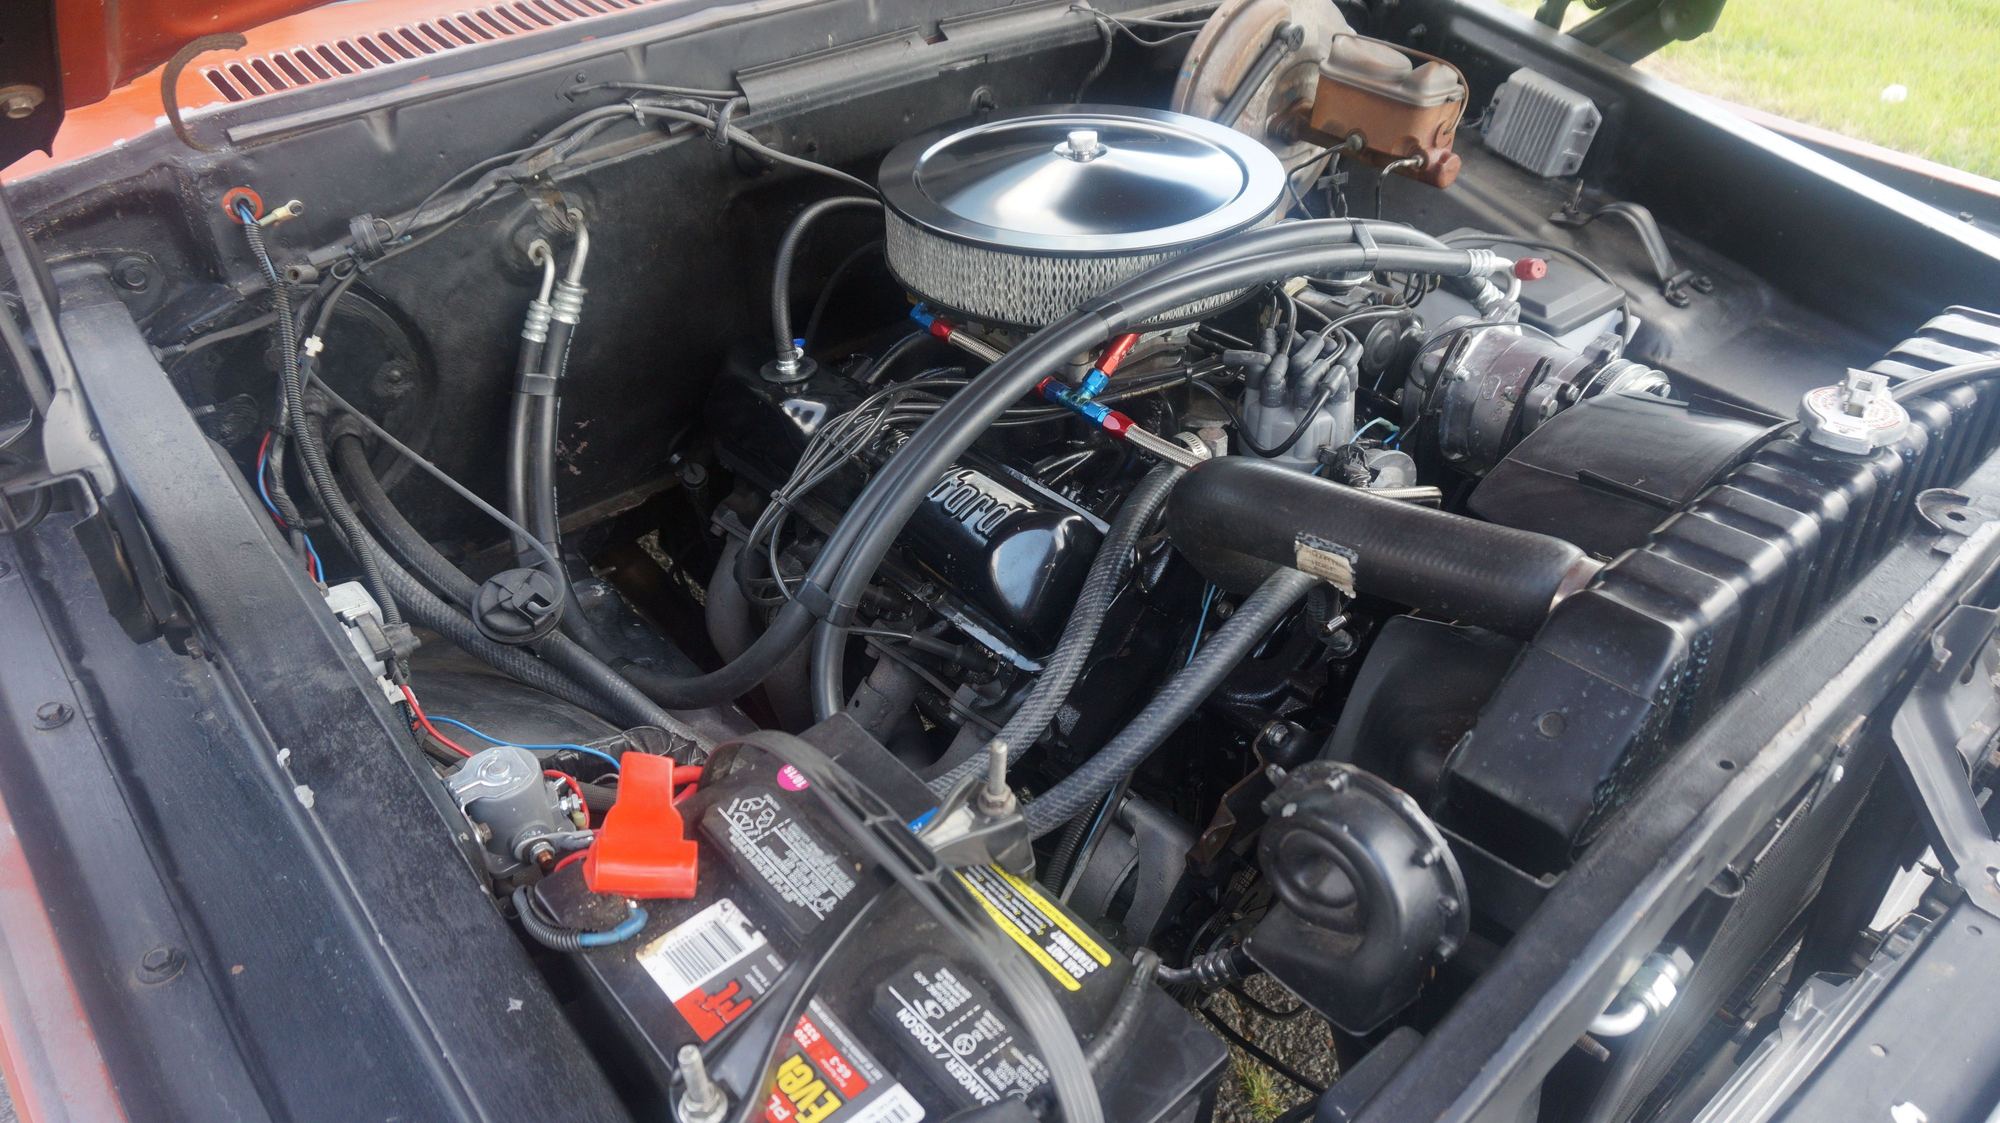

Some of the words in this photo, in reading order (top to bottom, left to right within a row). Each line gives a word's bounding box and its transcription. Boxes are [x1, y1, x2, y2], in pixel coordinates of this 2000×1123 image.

[1046, 942, 1069, 963] NOT
[1049, 929, 1098, 973] STARTING?
[1063, 957, 1086, 979] CAR
[896, 1008, 941, 1053] POISON
